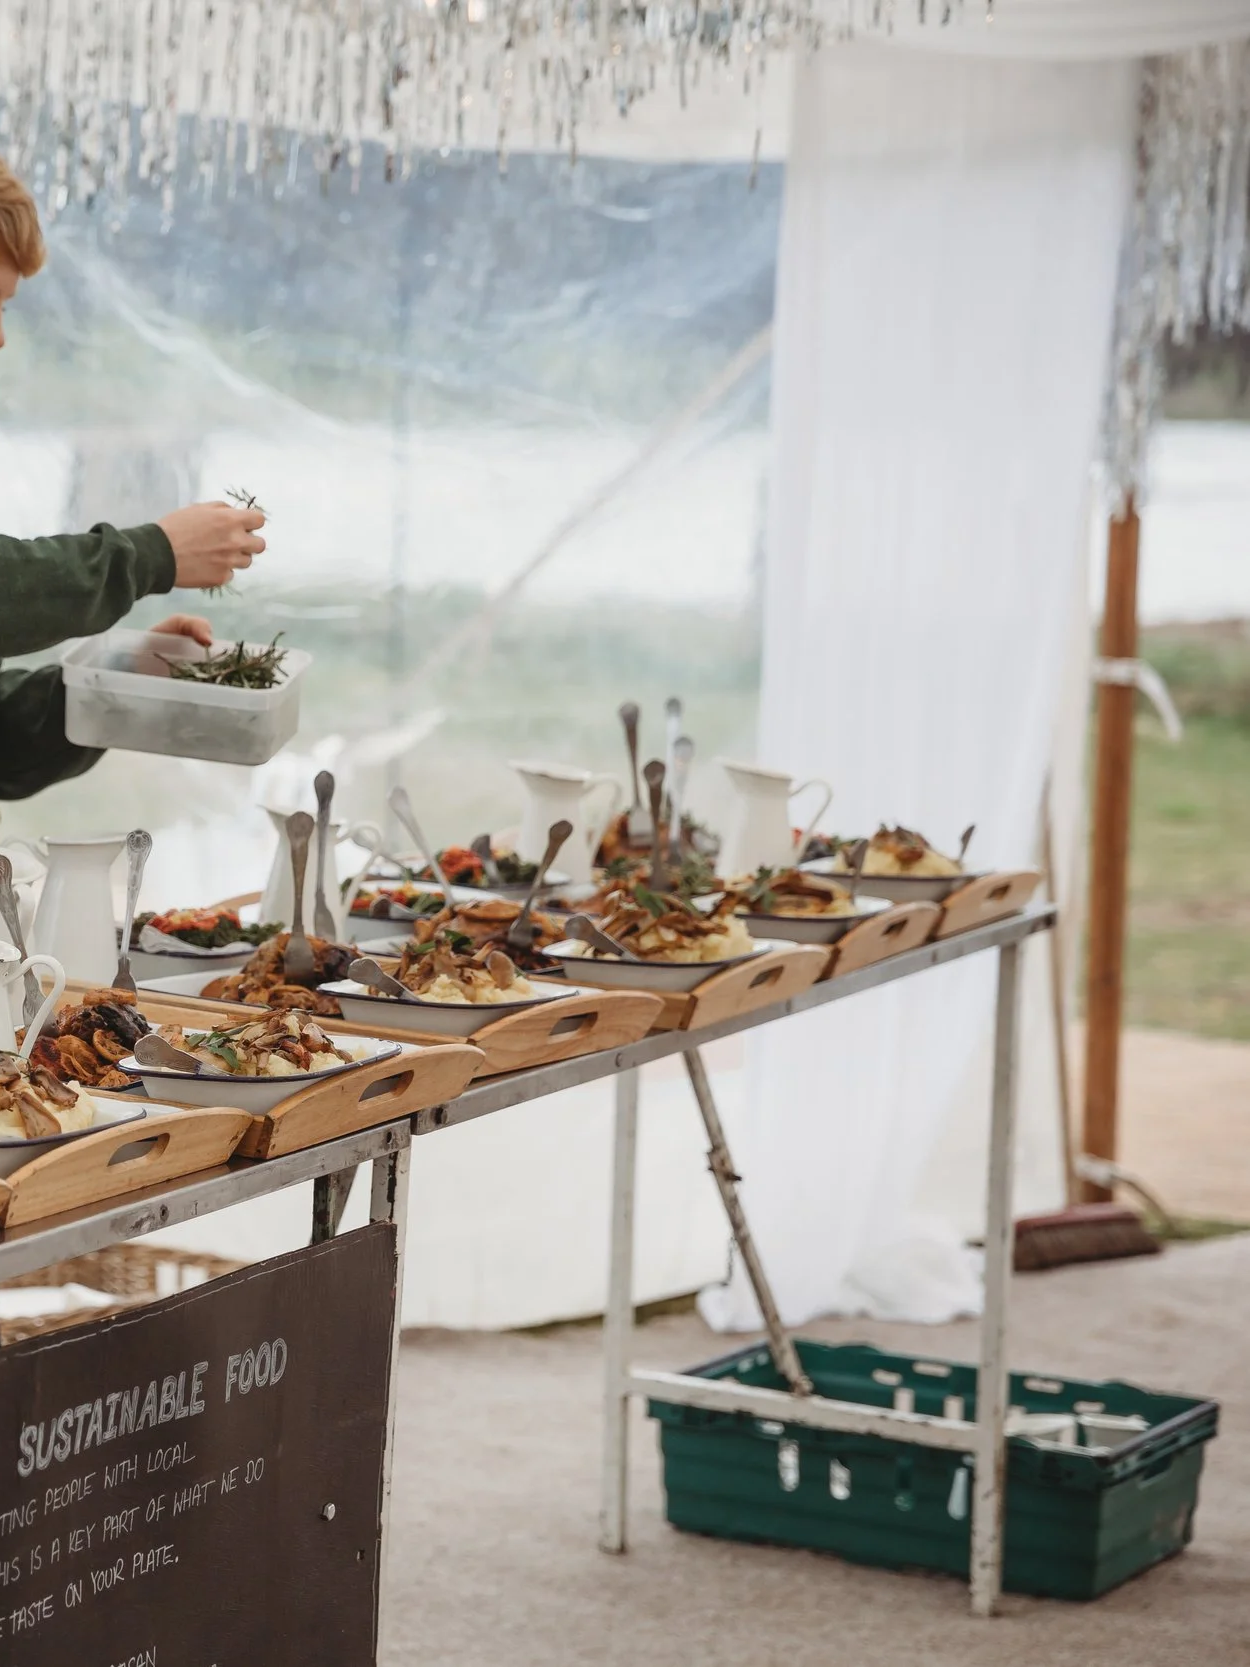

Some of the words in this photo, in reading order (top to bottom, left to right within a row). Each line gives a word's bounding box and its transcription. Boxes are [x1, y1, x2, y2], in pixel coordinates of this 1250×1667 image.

[17, 1360, 209, 1478] SUSTAINABLE
[224, 1337, 288, 1404] FOOD
[30, 1545, 42, 1575] IS
[50, 1537, 60, 1564] A
[69, 1523, 96, 1554] KEY
[103, 1506, 140, 1542] PART
[146, 1494, 166, 1522] OF
[173, 1479, 216, 1517] WHAT
[221, 1466, 239, 1495] WE
[245, 1457, 265, 1484] DO
[44, 1472, 97, 1515] PEOPLE
[104, 1454, 138, 1489] WITH
[146, 1441, 196, 1473] LOCAL
[9, 1594, 55, 1635] TASTE
[64, 1579, 83, 1608] ON
[90, 1558, 125, 1596] YOUR
[132, 1544, 179, 1579] PLATE.
